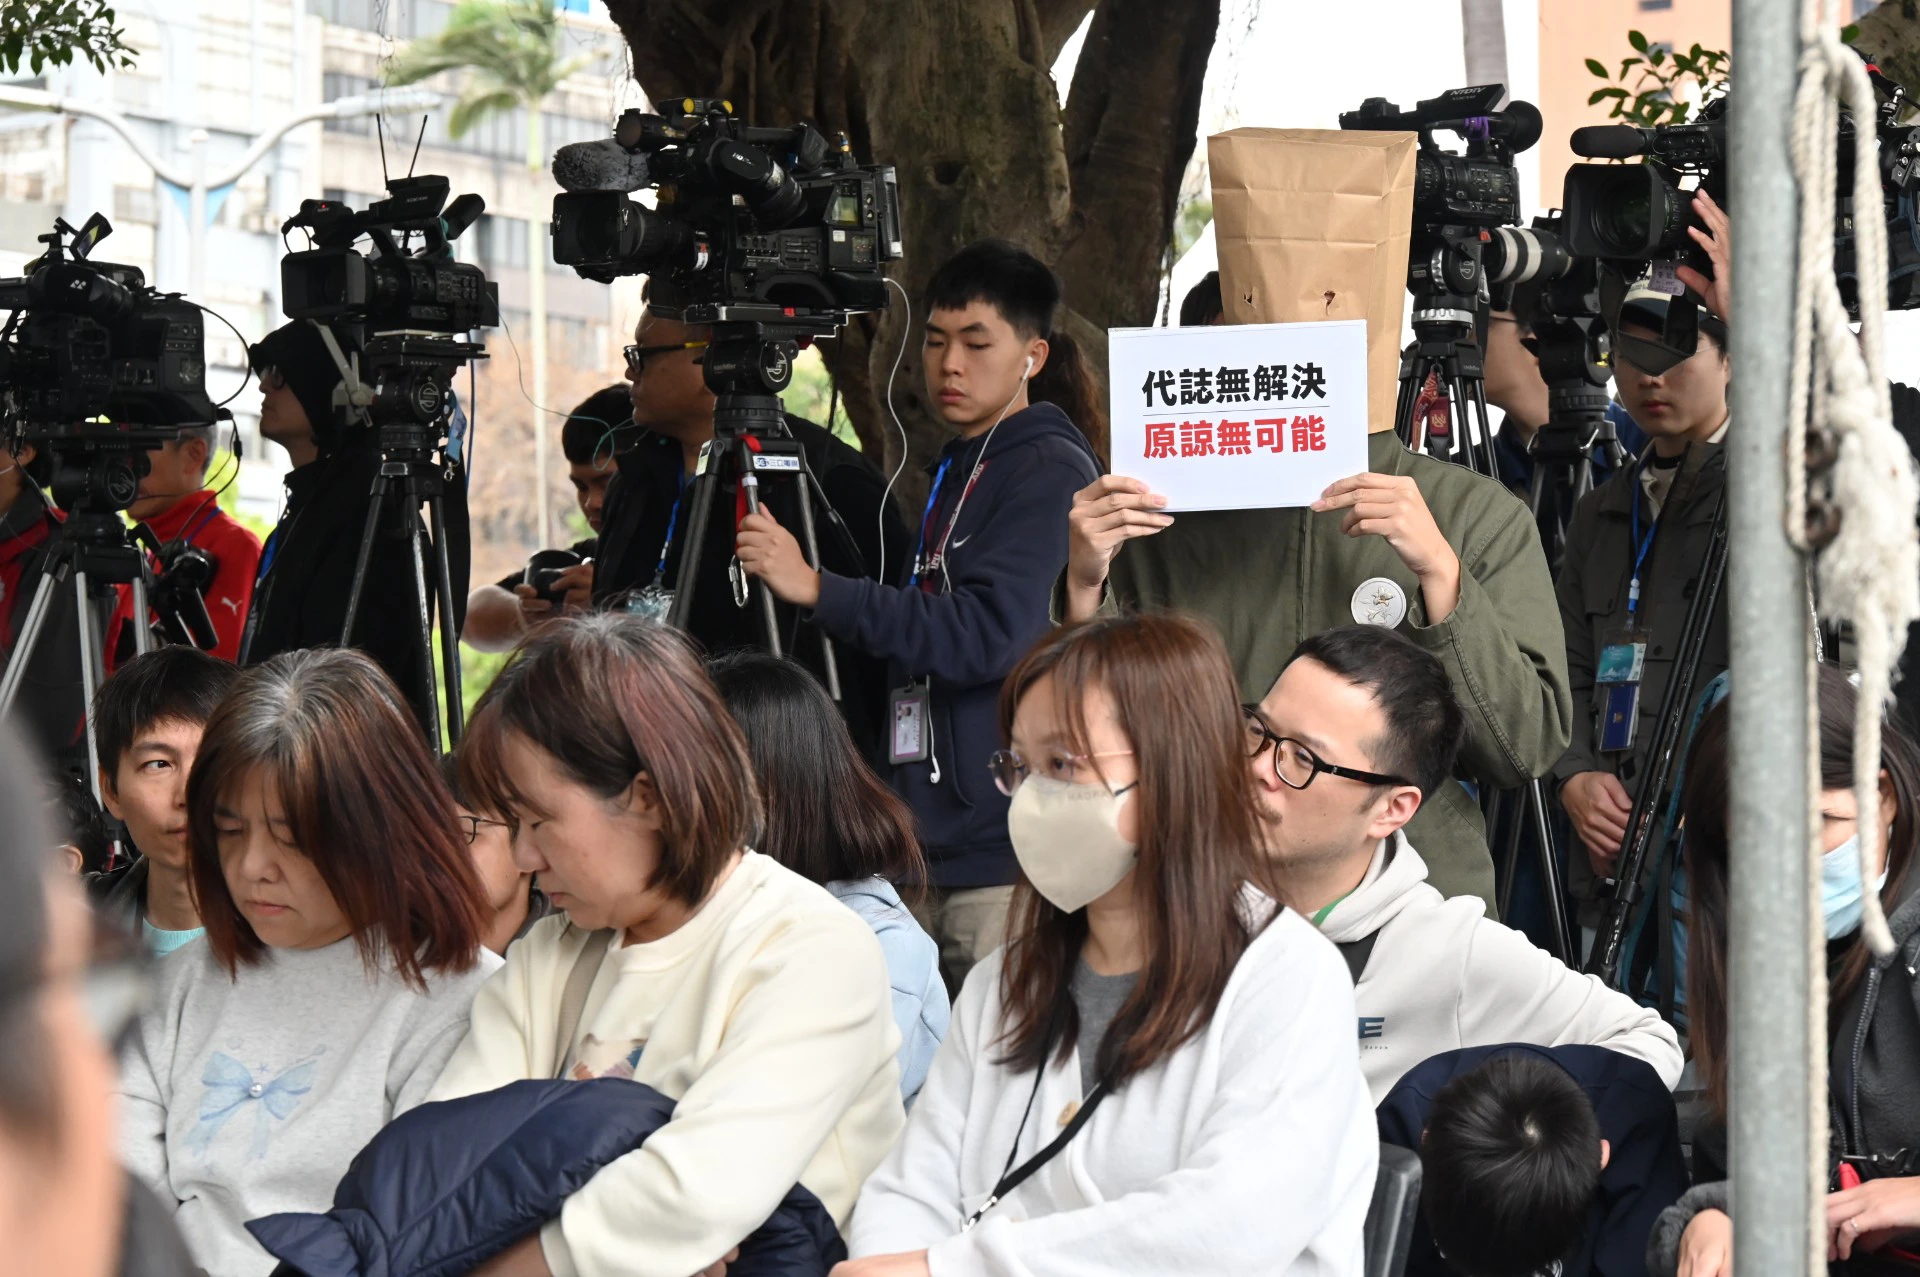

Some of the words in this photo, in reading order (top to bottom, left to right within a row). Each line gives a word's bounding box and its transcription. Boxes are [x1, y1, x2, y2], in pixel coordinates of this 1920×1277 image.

[1142, 362, 1327, 407] 代誌無解決
[1143, 415, 1327, 459] 原諒無可能
